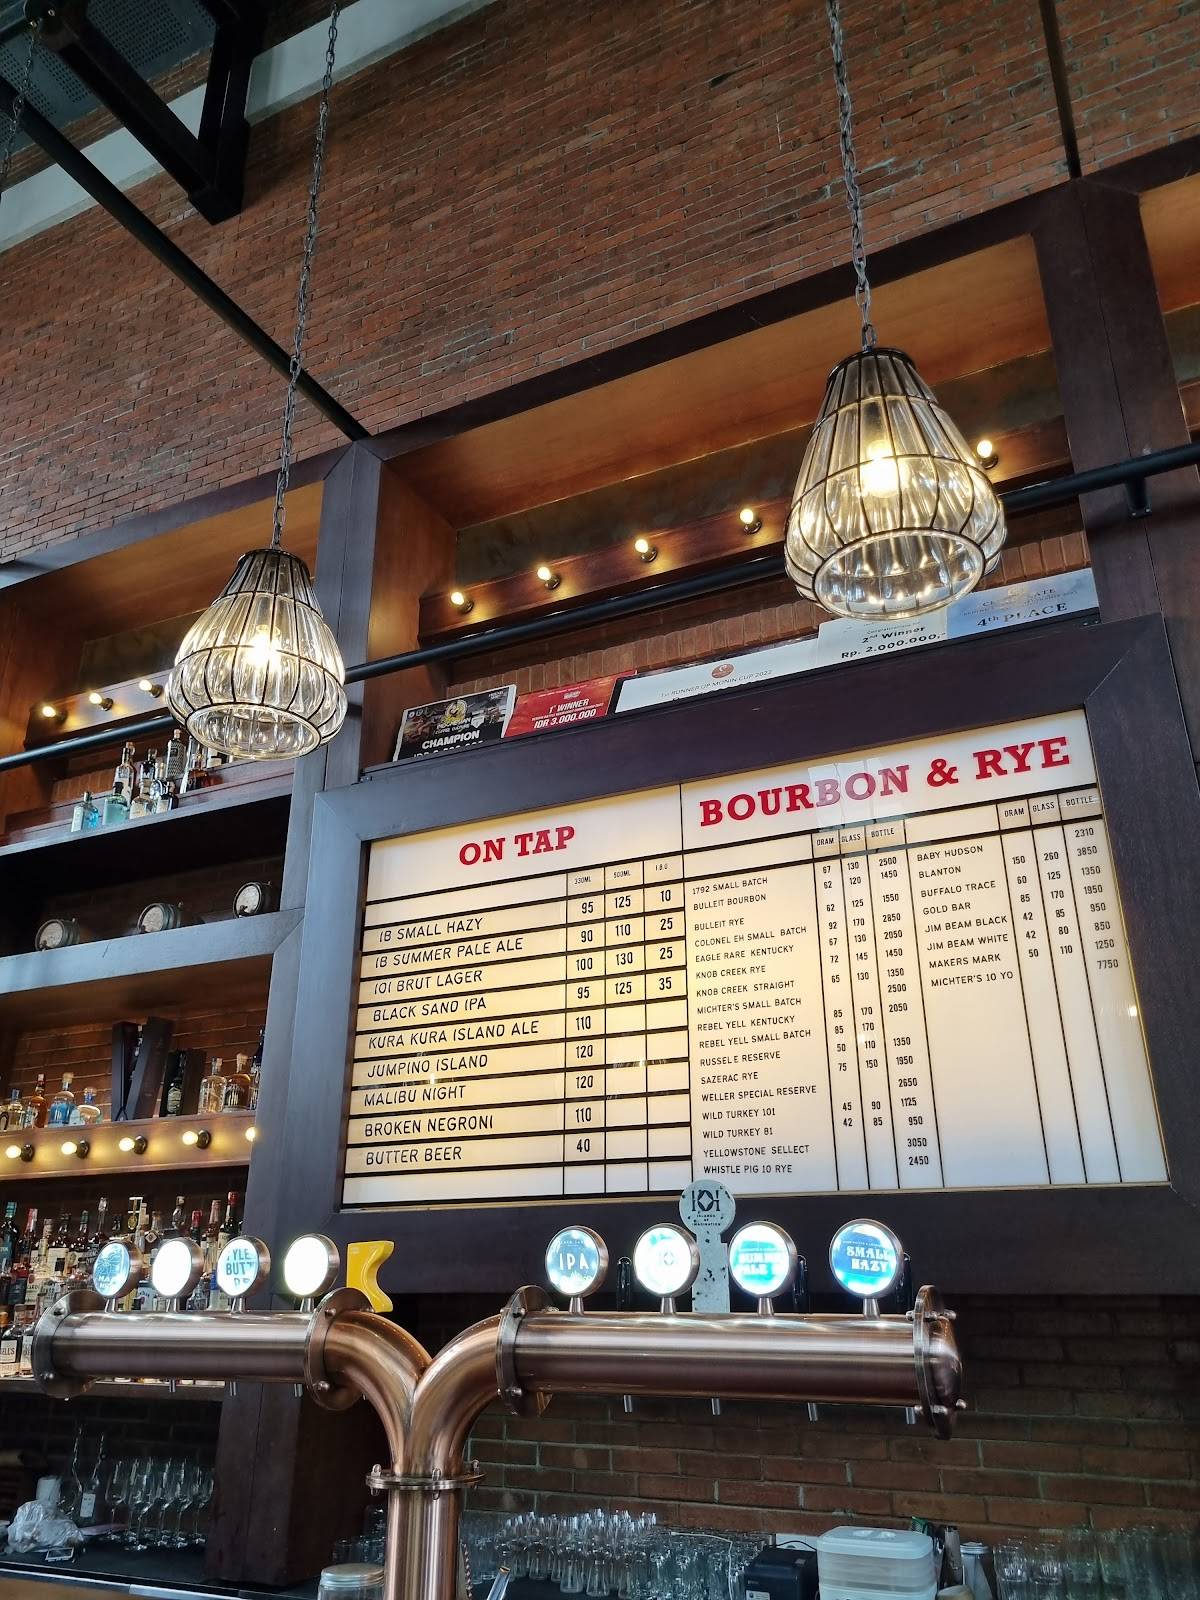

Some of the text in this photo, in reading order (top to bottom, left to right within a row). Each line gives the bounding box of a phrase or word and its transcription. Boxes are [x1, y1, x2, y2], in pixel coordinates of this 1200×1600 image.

[976, 615, 1000, 626] 4th
[1004, 602, 1068, 622] PLACE
[882, 626, 926, 638] Winner
[841, 650, 860, 658] Rp.
[557, 698, 590, 711] WINNER
[534, 719, 550, 729] IDR
[550, 708, 596, 726] 3.000.000
[422, 730, 480, 750] CHAMPION
[699, 736, 1070, 827] BOURBON & RYE
[1004, 795, 1094, 818] DRAM GLASS BOTTLE
[459, 825, 575, 866] ON TAP
[816, 827, 895, 846] DRAM GLASS BOTTLE
[916, 827, 1094, 862] BABY HUDSON 2310
[918, 845, 1098, 879] BLANTON 3850
[692, 877, 768, 895] 1792 SMALL BATCH
[920, 865, 1101, 898] BUFFALO TRACE 1350
[693, 894, 766, 911] BULLEIT BOURBON
[922, 884, 1103, 915] GOLD BAR 1950
[397, 923, 442, 940] SMALL
[447, 917, 483, 934] HAZY
[581, 901, 594, 914] 95
[614, 895, 631, 909] 125
[660, 889, 671, 902] 10
[694, 917, 745, 931] BULLEIT RYE
[924, 902, 1106, 933] JIM BEAM BLACK 950
[392, 947, 452, 966] SUMMER
[457, 941, 492, 958] PALE
[496, 937, 524, 953] ALE
[580, 929, 593, 943] 90
[615, 923, 631, 937] 110
[660, 917, 673, 931] 25
[694, 926, 807, 948] COLONEL EH SMALL BATCH
[927, 921, 1111, 951] JIM BEAM WHITE 850
[695, 944, 794, 963] EAGLE RARE KENTUCKY
[929, 938, 1115, 969] MAKERS MARK 1250
[396, 976, 432, 992] BRUT
[436, 970, 483, 987] LAGER
[576, 957, 593, 971] 100
[615, 951, 633, 966] 130
[659, 946, 673, 960] 25
[696, 965, 766, 979] KNOB CREEK RYE
[930, 958, 1119, 987] MICHTER'S 10 YO 7750
[373, 976, 672, 1022] BLACK SAND IPA 95 125 35
[696, 980, 794, 998] KNOB CREEK STRAIGHT
[697, 997, 802, 1014] MICHTER'S SMALL BATCH
[368, 1015, 591, 1050] KURA KURA ISLAND ALE 110
[697, 1015, 795, 1032] REBEL YELL KENTUCKY
[699, 1029, 811, 1049] REBEL YELL SMALL BATCH
[436, 1054, 488, 1072] ISLAND
[575, 1044, 593, 1059] 120
[741, 1050, 781, 1062] RESERVE
[700, 1071, 759, 1085] SAZERAC RYE
[364, 1075, 594, 1107] MALIBU NIGHT 120
[701, 1085, 817, 1102] WELLER SPECIAL RESERVE
[364, 1107, 592, 1137] BROKEN NEGRONI 110
[702, 1111, 723, 1120] WILD
[726, 1108, 759, 1119] TURKEY
[702, 1127, 773, 1139] WILD TURKEY 81
[366, 1138, 590, 1166] BUTTER BEER 40
[703, 1144, 810, 1158] YELLOWSTONE SELLECT
[703, 1164, 792, 1174] WHISTLE PIG 10 RYE
[560, 1252, 589, 1270] IPA
[846, 1246, 888, 1260] SMALL
[852, 1258, 888, 1272] HAZY
